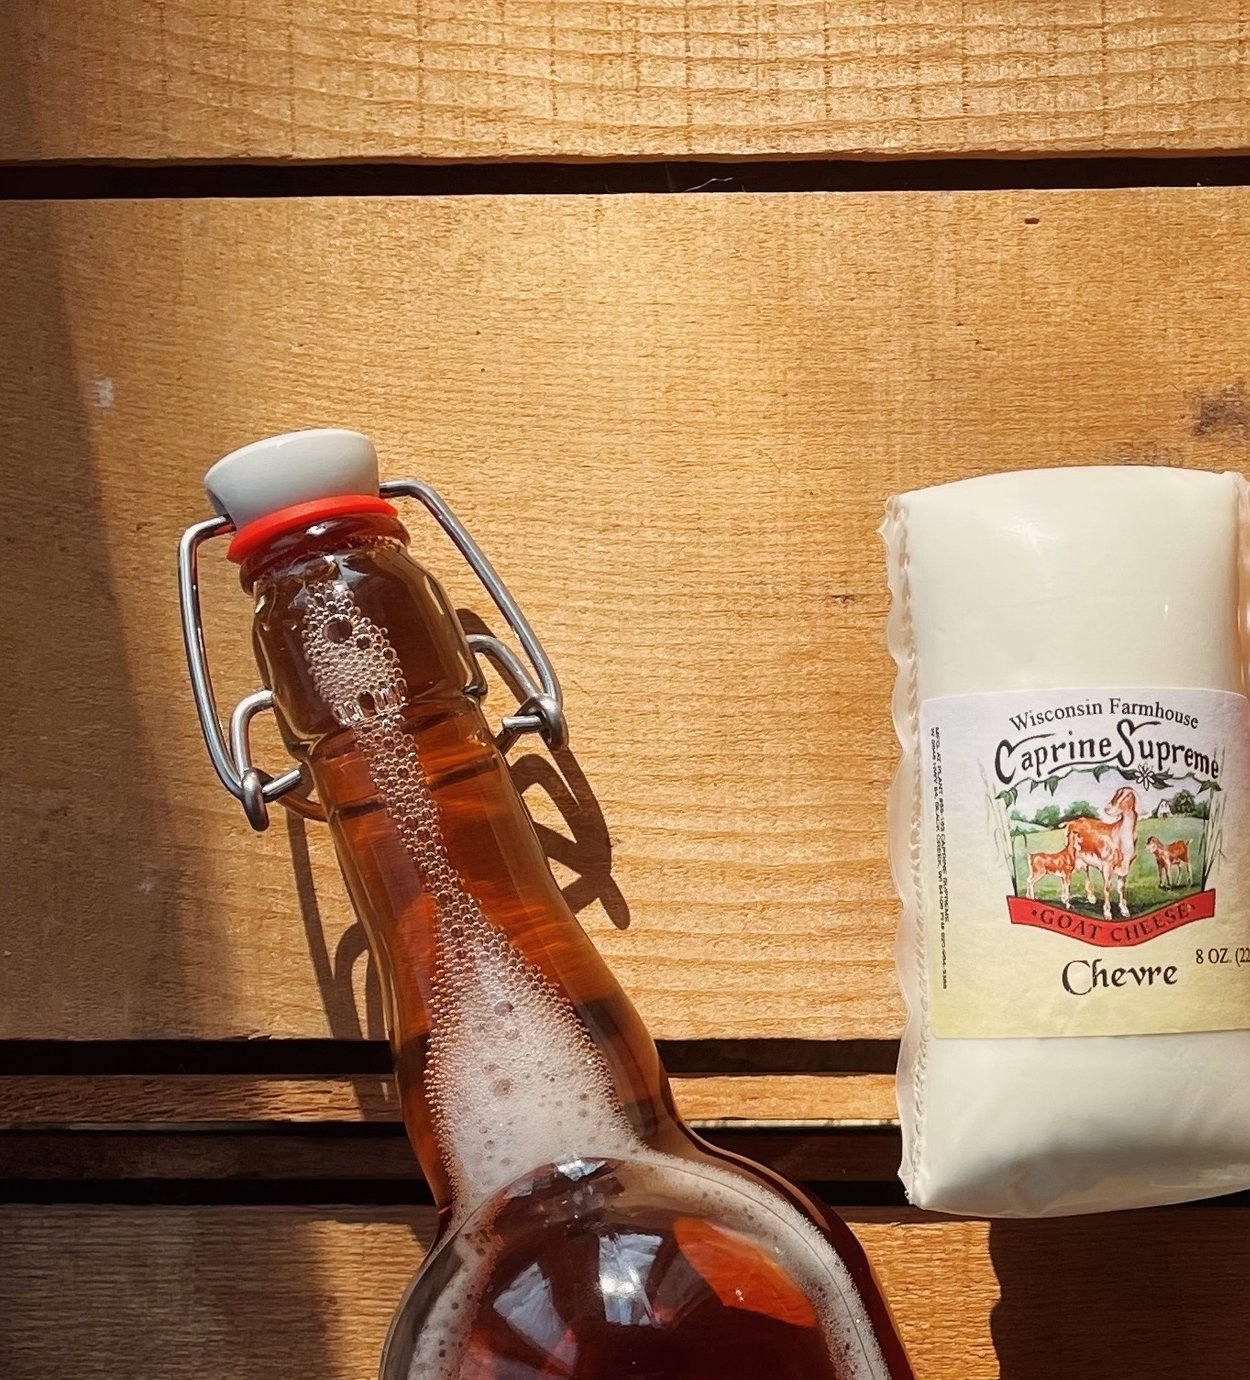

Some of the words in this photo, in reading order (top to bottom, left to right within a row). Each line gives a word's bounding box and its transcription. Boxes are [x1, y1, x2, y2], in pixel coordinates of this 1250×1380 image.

[1009, 699, 1102, 731] Wisconsin
[1109, 698, 1199, 729] Farmhouse
[995, 731, 1112, 784] Caprine
[1116, 718, 1219, 779] Supreme
[1040, 909, 1103, 940] GOAT
[1110, 902, 1189, 942] CHEESE
[1195, 949, 1204, 964] 8
[1208, 948, 1232, 964] OZ.
[1062, 959, 1178, 995] Chevre
